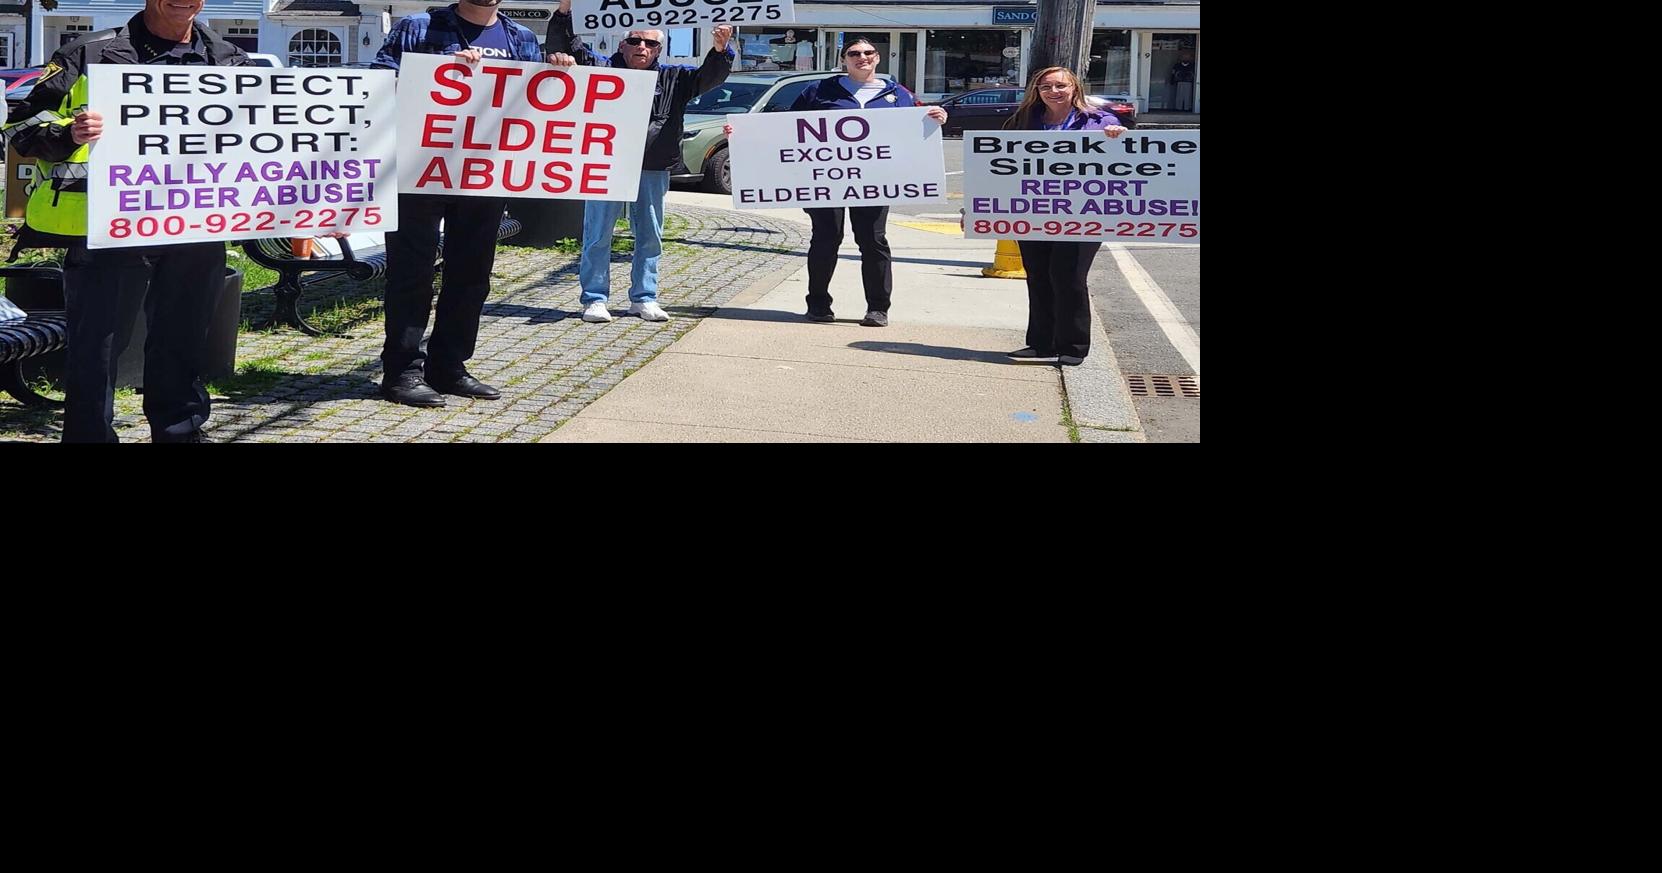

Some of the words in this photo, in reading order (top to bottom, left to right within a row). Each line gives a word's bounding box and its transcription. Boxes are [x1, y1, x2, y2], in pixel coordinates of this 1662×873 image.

[584, 4, 781, 30] 800-922-2275
[997, 11, 1030, 20] SAND
[121, 72, 369, 100] RESPECT,
[430, 62, 625, 113] STOP
[120, 104, 371, 129] PROTECT,
[421, 113, 616, 156] ELDER
[796, 115, 870, 144] NO
[138, 132, 357, 156] REPORT:
[779, 145, 892, 163] EXCUSE
[973, 136, 1106, 154] Break
[1121, 136, 1198, 155] the
[109, 162, 227, 187] RALLY
[234, 159, 381, 182] AGAINST
[416, 156, 611, 195] ABUSE
[812, 167, 862, 181] FOR
[989, 157, 1176, 177] Silence:
[119, 187, 240, 212] ELDER
[251, 182, 374, 206] ABUSE!
[740, 186, 831, 204] ELDER
[843, 183, 939, 200] ABUSE
[1021, 179, 1149, 197] REPORT
[972, 197, 1073, 215] ELDER
[1079, 199, 1199, 217] ABUSE!
[109, 206, 382, 239] 800-922-2275
[973, 219, 1199, 238] 800-922-2275
